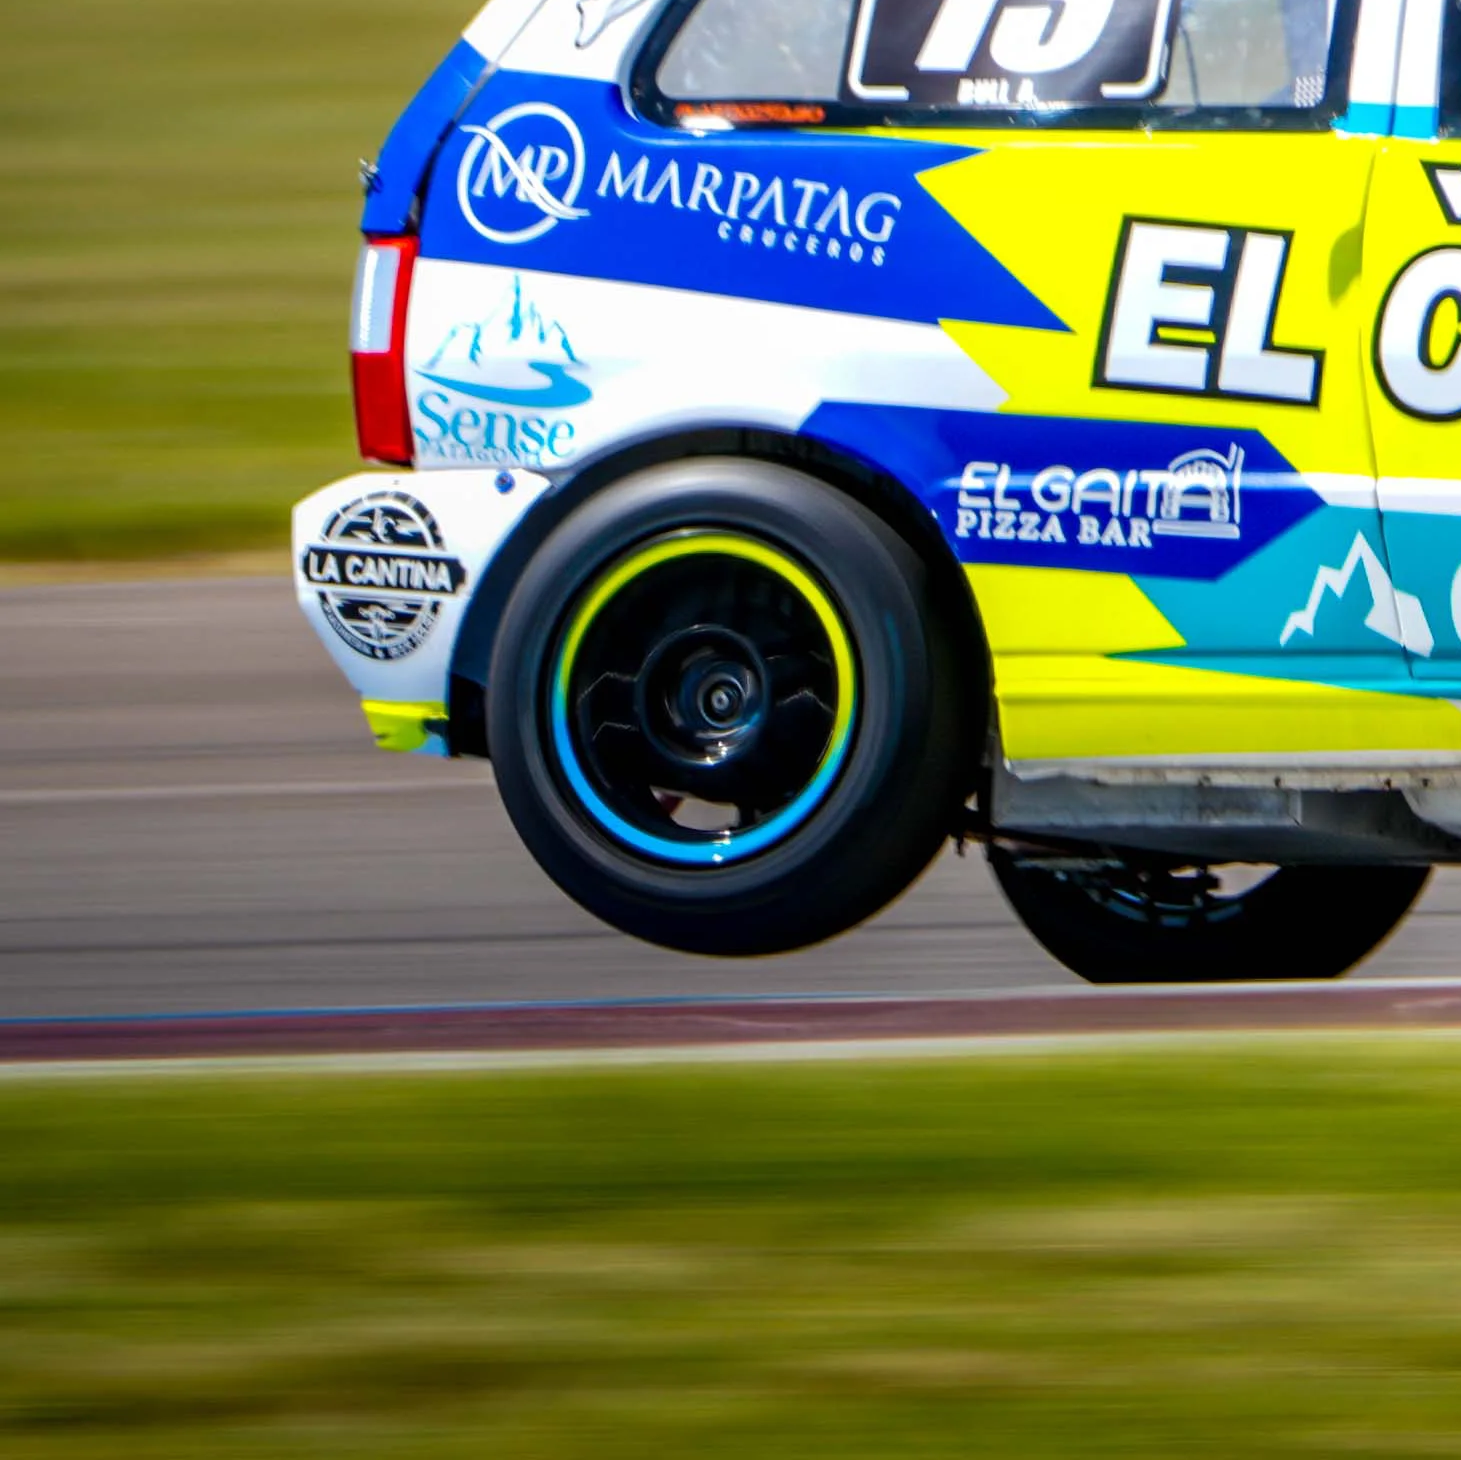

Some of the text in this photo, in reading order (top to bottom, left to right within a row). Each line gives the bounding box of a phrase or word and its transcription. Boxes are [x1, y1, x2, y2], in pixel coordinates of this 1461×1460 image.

[597, 149, 903, 243] MARPATAG
[717, 220, 887, 268] CRUCEROS
[1092, 213, 1328, 411] EL
[414, 390, 577, 459] Sense
[958, 461, 1021, 510] EL
[954, 507, 1153, 549] PIZZA BAR
[308, 550, 454, 593] LA CANTINA
